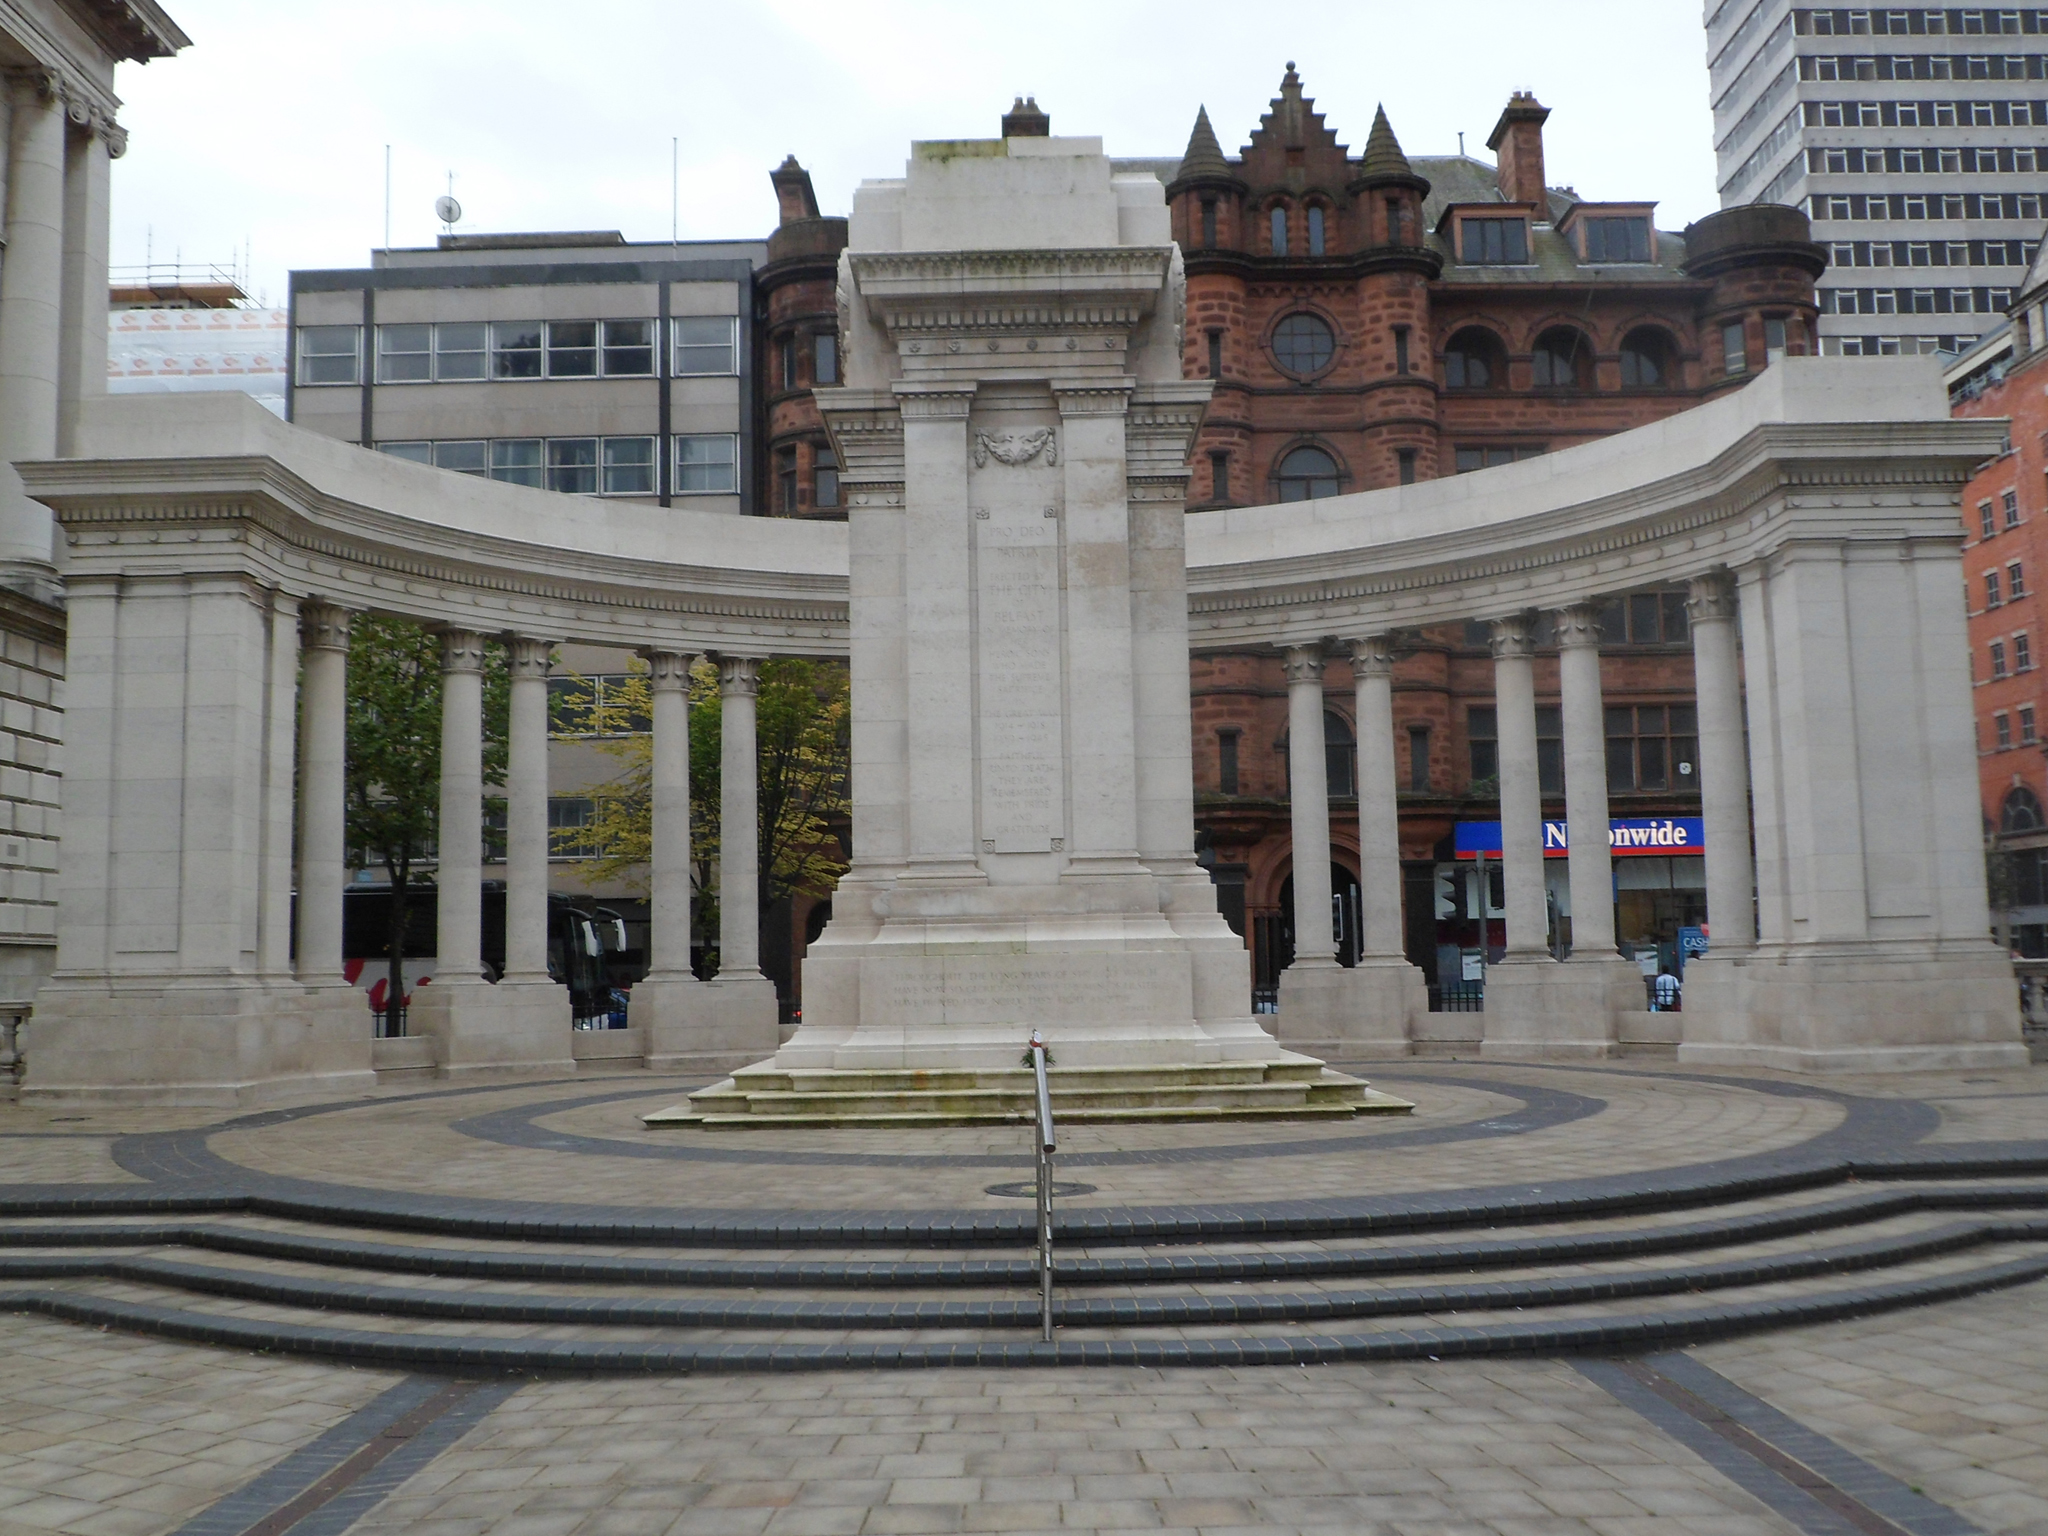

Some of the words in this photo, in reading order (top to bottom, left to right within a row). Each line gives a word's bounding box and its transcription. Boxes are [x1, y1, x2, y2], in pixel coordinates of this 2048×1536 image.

[990, 526, 1013, 537] PRO
[1020, 526, 1045, 537] DEO
[989, 584, 1012, 596] THE
[1018, 583, 1047, 596] CITY
[994, 610, 1043, 622] BELFAST
[998, 776, 1022, 785] THEY
[1025, 776, 1047, 785] ARE
[994, 801, 1019, 810] WITH
[1025, 800, 1049, 809] PRIDE
[1011, 812, 1033, 822] AND
[996, 824, 1050, 834] GRATITUDE
[969, 971, 986, 981] THE
[990, 971, 1018, 980] LONG
[1020, 970, 1052, 979] YEARS
[894, 986, 918, 994] HAVE
[894, 999, 918, 1007] HAVE
[1028, 996, 1052, 1005] THEY
